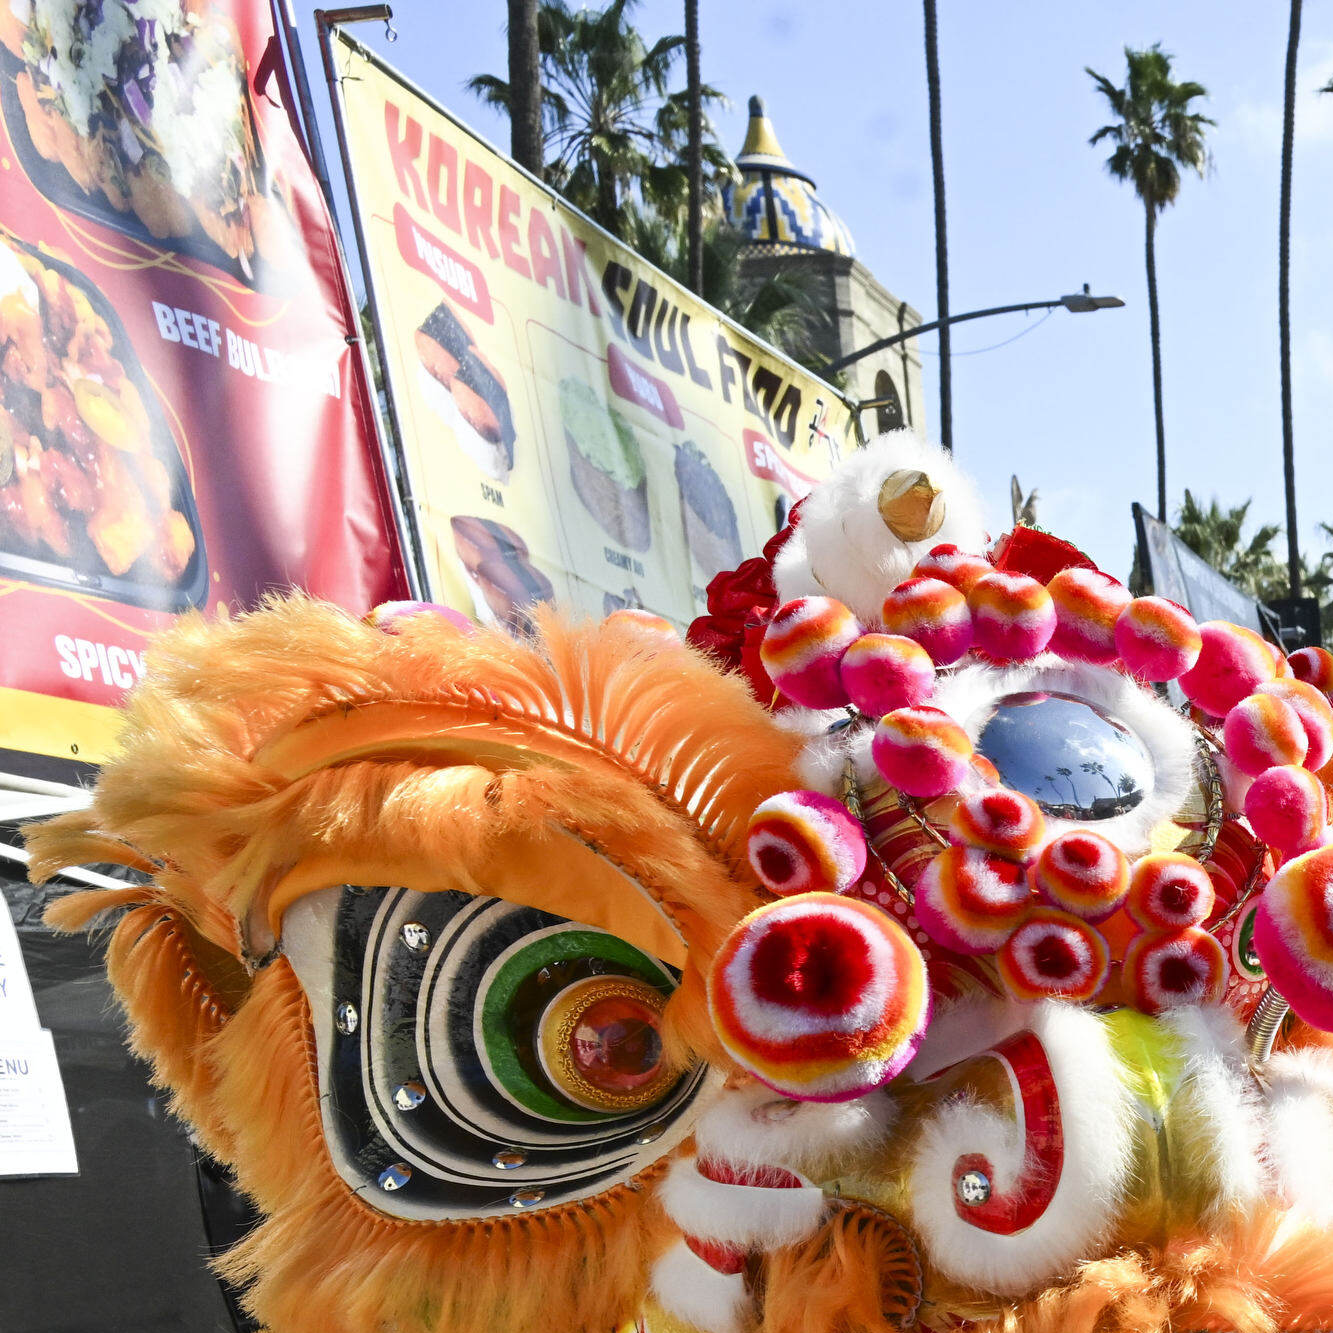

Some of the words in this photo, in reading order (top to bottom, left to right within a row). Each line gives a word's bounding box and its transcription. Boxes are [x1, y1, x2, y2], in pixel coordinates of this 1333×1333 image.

[384, 99, 601, 317] KOREAN
[601, 260, 713, 392] SOUL
[152, 300, 222, 358] BEEF
[226, 327, 341, 399] BULI
[481, 483, 504, 507] SPAM
[54, 634, 148, 690] SPICY
